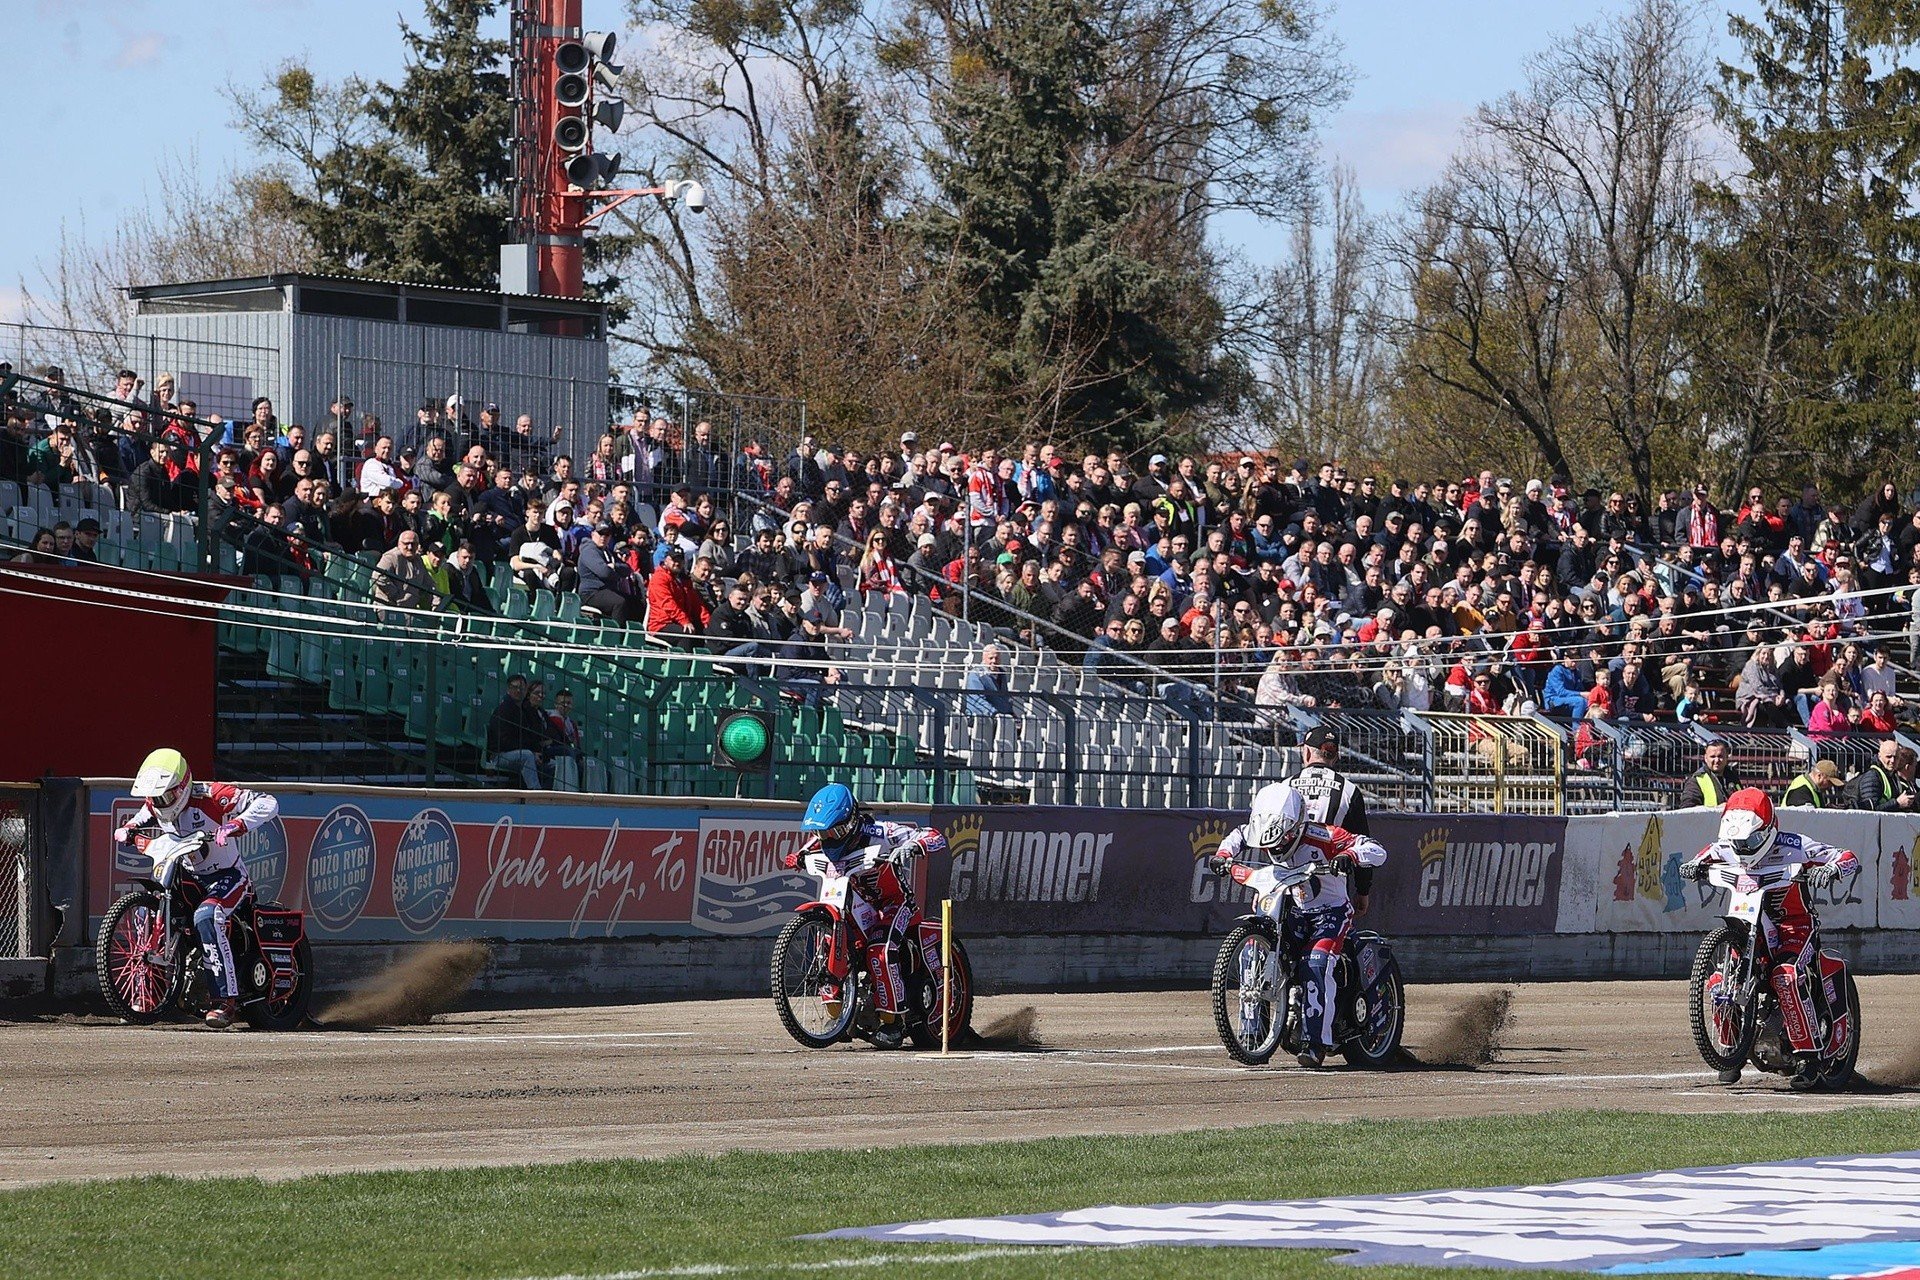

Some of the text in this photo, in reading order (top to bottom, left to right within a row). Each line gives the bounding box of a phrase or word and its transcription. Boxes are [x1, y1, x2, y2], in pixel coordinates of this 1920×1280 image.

[1290, 777, 1342, 791] KIEROWNIK
[1298, 786, 1332, 798] STARTU
[860, 822, 883, 836] Nice
[1776, 832, 1801, 847] Nice
[311, 845, 371, 878] DUŻO RYBY
[398, 838, 450, 871] MROŻENIE
[702, 828, 815, 884] ABRAMCZY
[313, 867, 366, 895] MAŁO LODU
[412, 861, 454, 896] jest OK!
[474, 815, 550, 919] Jak
[557, 817, 646, 938] ryby,
